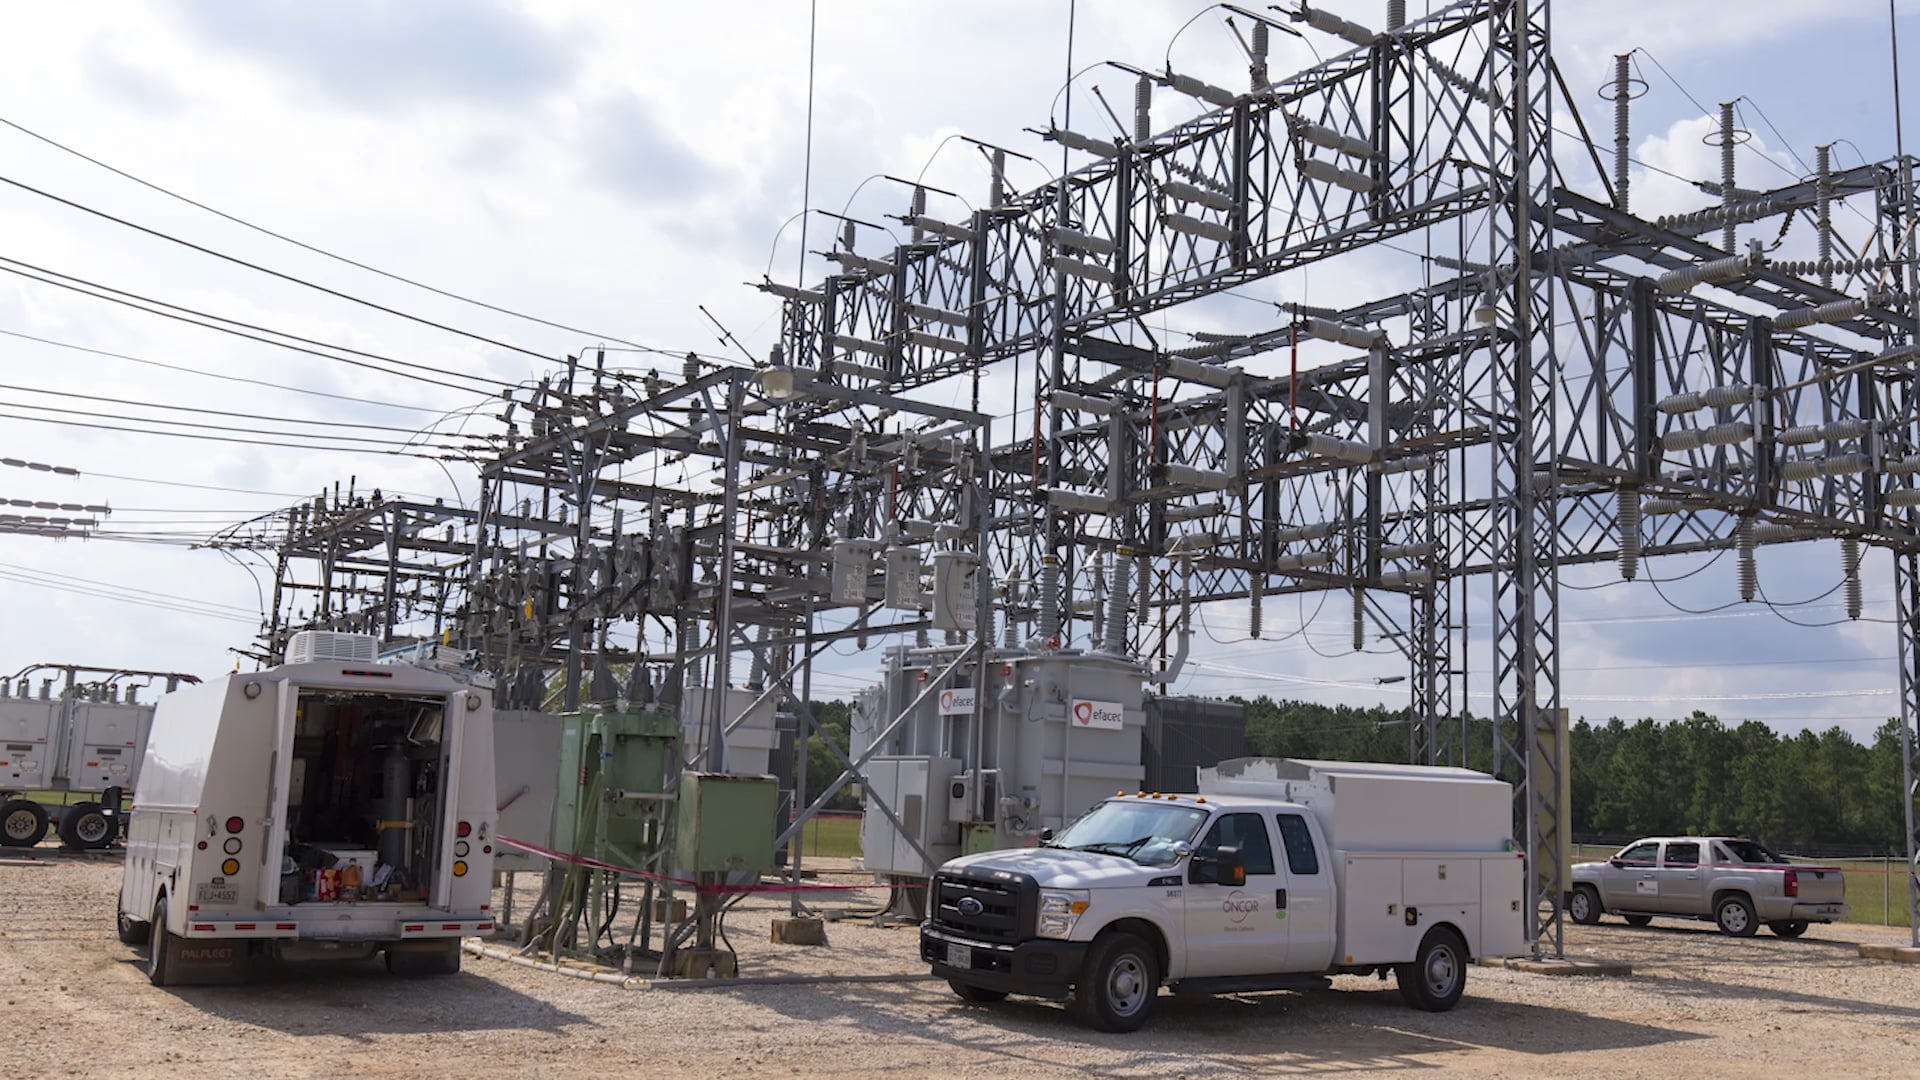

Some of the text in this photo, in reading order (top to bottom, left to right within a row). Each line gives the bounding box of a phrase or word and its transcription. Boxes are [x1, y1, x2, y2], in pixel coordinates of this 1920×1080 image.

[952, 695, 975, 707] efacec
[1092, 708, 1122, 722] efacec
[1222, 900, 1259, 913] ONCOR
[180, 948, 233, 960] PALFLEET
